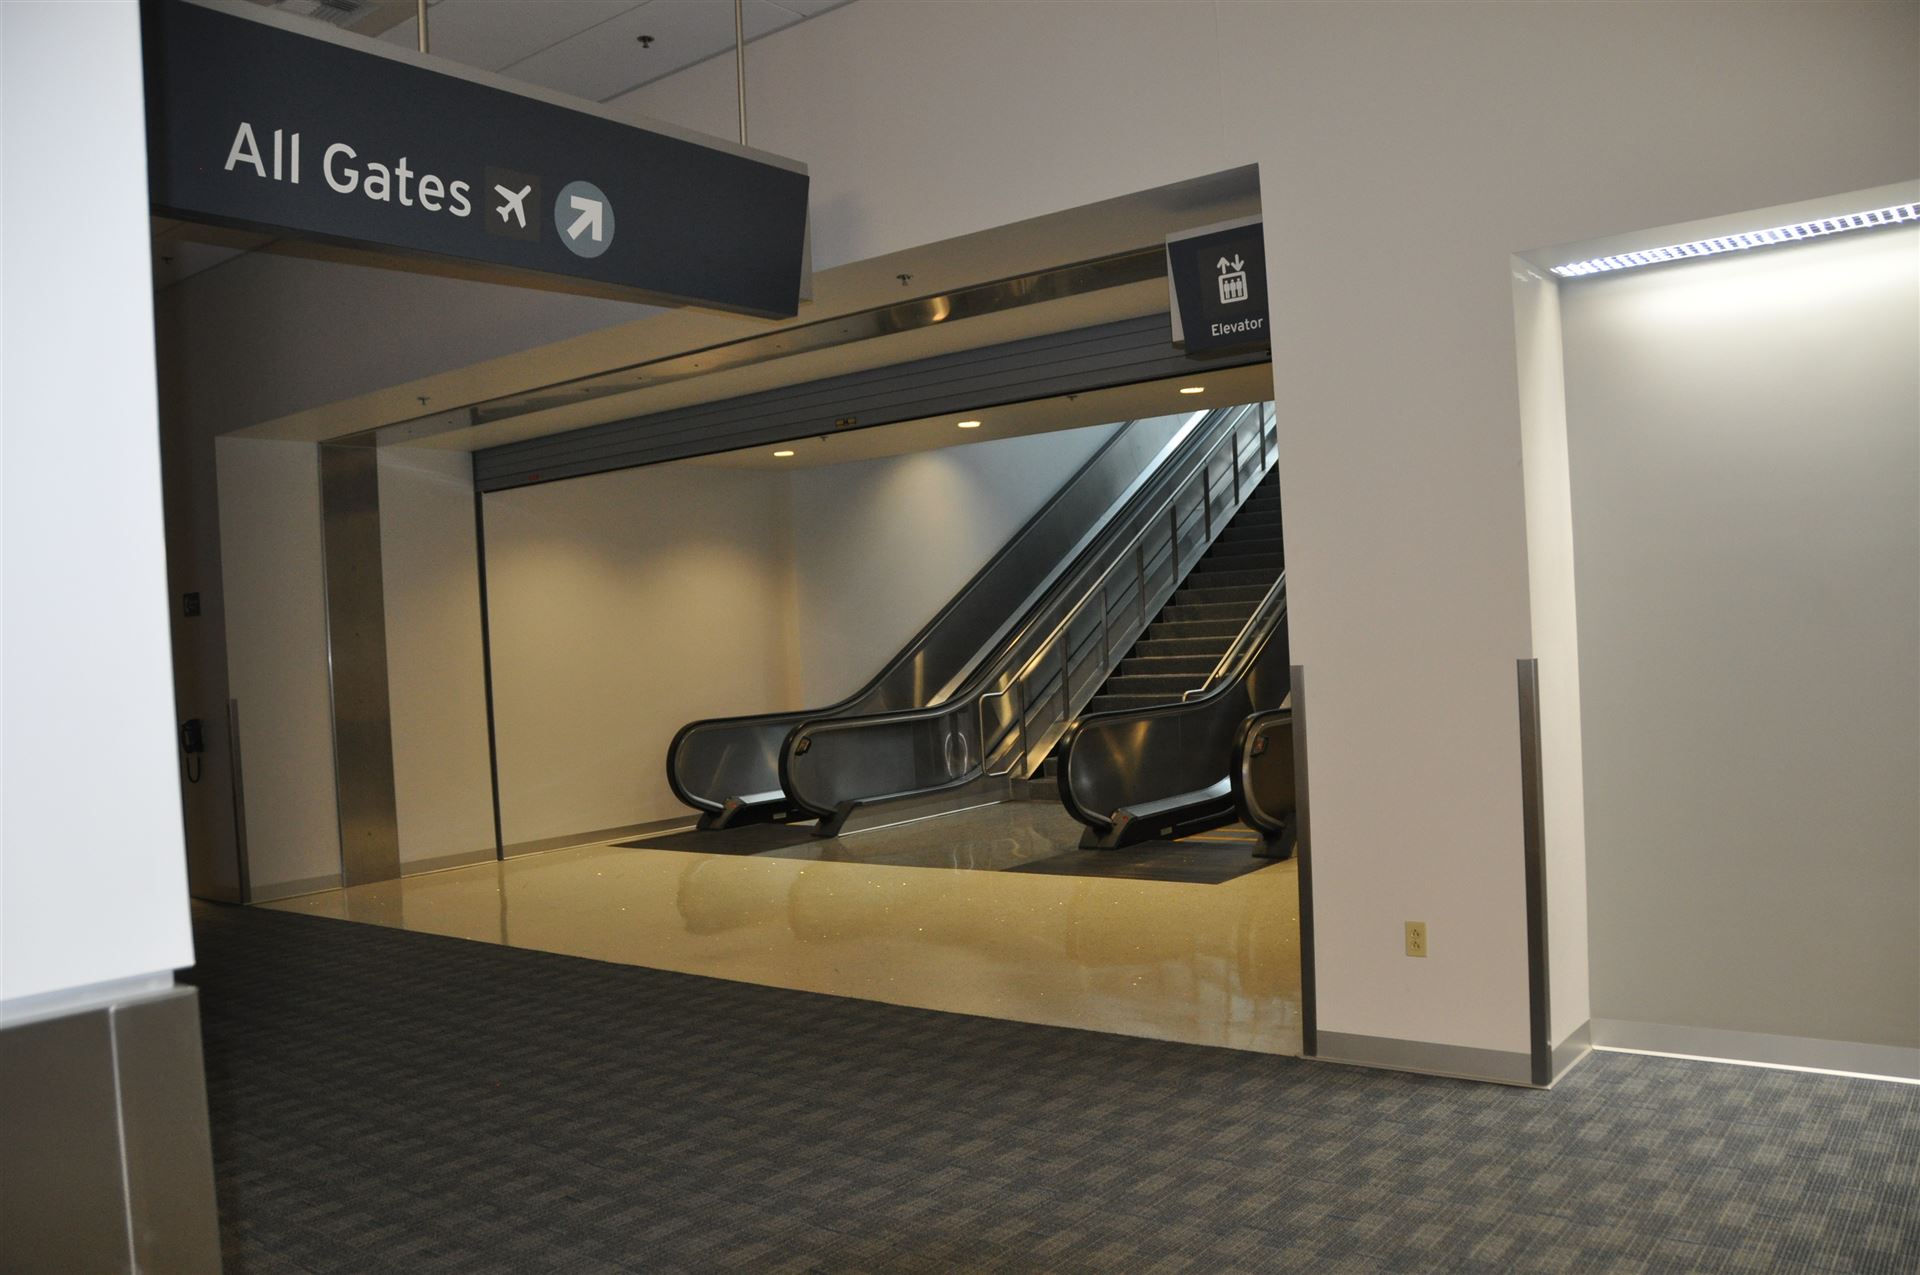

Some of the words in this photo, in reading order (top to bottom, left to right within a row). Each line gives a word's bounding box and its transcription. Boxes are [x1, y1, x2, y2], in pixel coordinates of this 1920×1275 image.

[224, 122, 300, 184] All
[323, 143, 472, 217] Gates
[1211, 318, 1263, 336] Elevator
